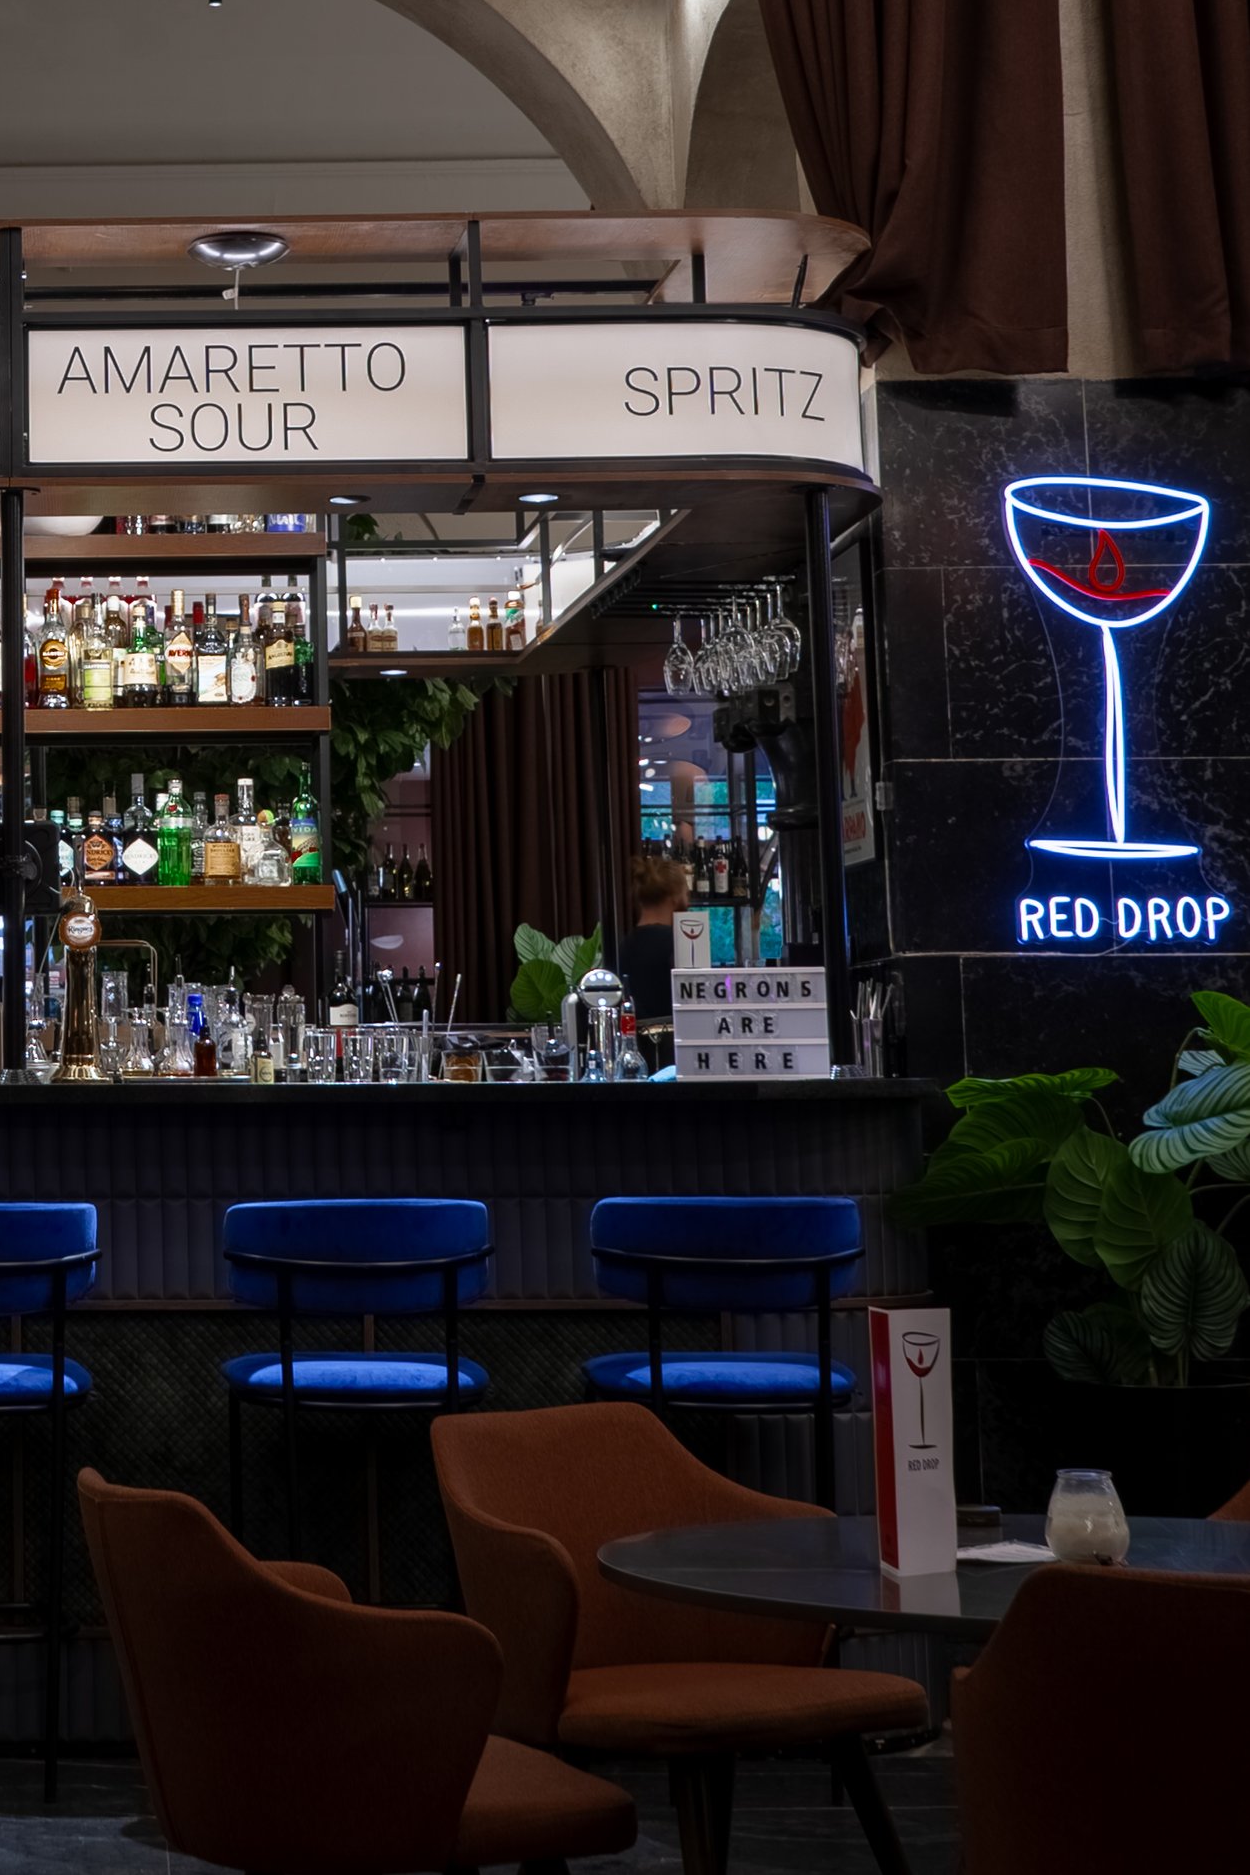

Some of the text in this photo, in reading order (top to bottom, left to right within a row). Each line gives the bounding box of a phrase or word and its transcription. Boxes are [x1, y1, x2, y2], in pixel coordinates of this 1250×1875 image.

[57, 342, 406, 395] AMARETTO
[624, 366, 825, 422] SPRITZ
[149, 402, 319, 452] SOUR
[1018, 895, 1230, 942] RED DROP
[680, 980, 812, 1000] NEGRONS
[717, 1016, 775, 1035] ARE
[696, 1051, 794, 1070] HERE
